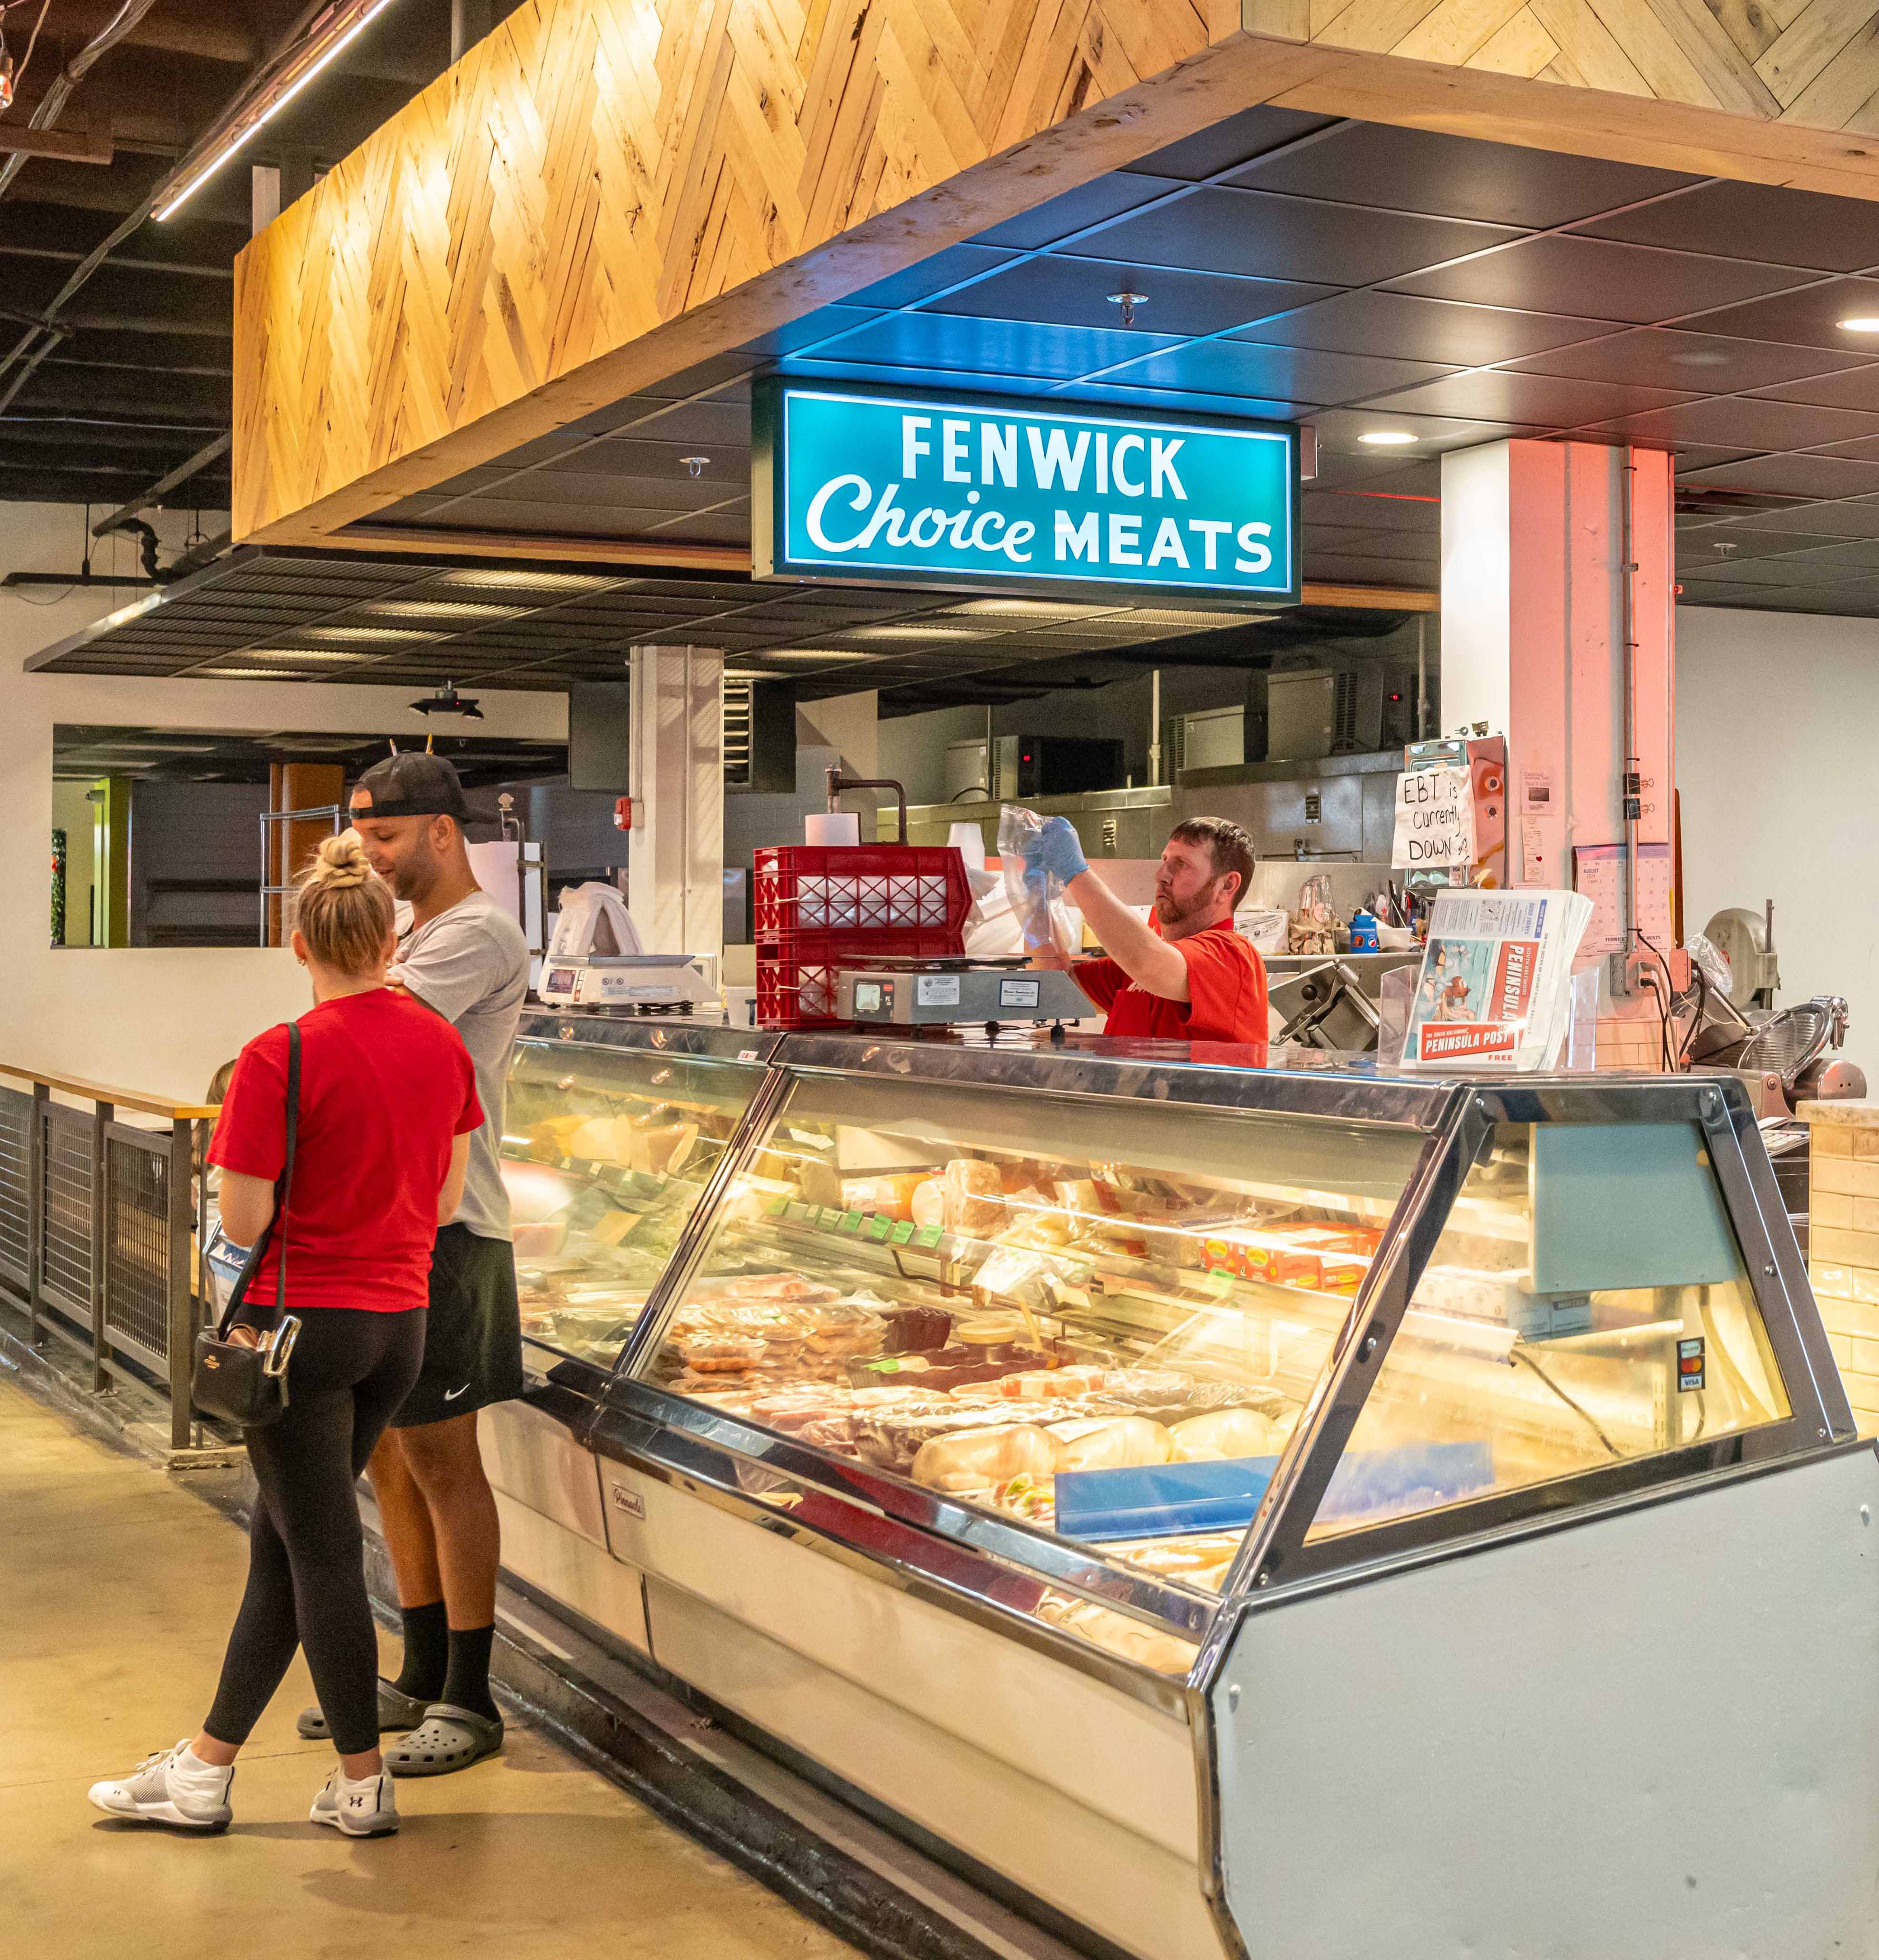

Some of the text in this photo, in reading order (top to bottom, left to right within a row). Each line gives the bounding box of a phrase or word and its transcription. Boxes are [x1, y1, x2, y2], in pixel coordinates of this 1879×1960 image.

[901, 415, 1188, 500] FENWICK
[806, 474, 1272, 573] Choice MEATS
[1404, 774, 1458, 804] EBT is
[1409, 837, 1451, 860] DOWN
[1501, 945, 1524, 1021] PENINSULA
[1425, 1031, 1509, 1054] PENINSULA POST
